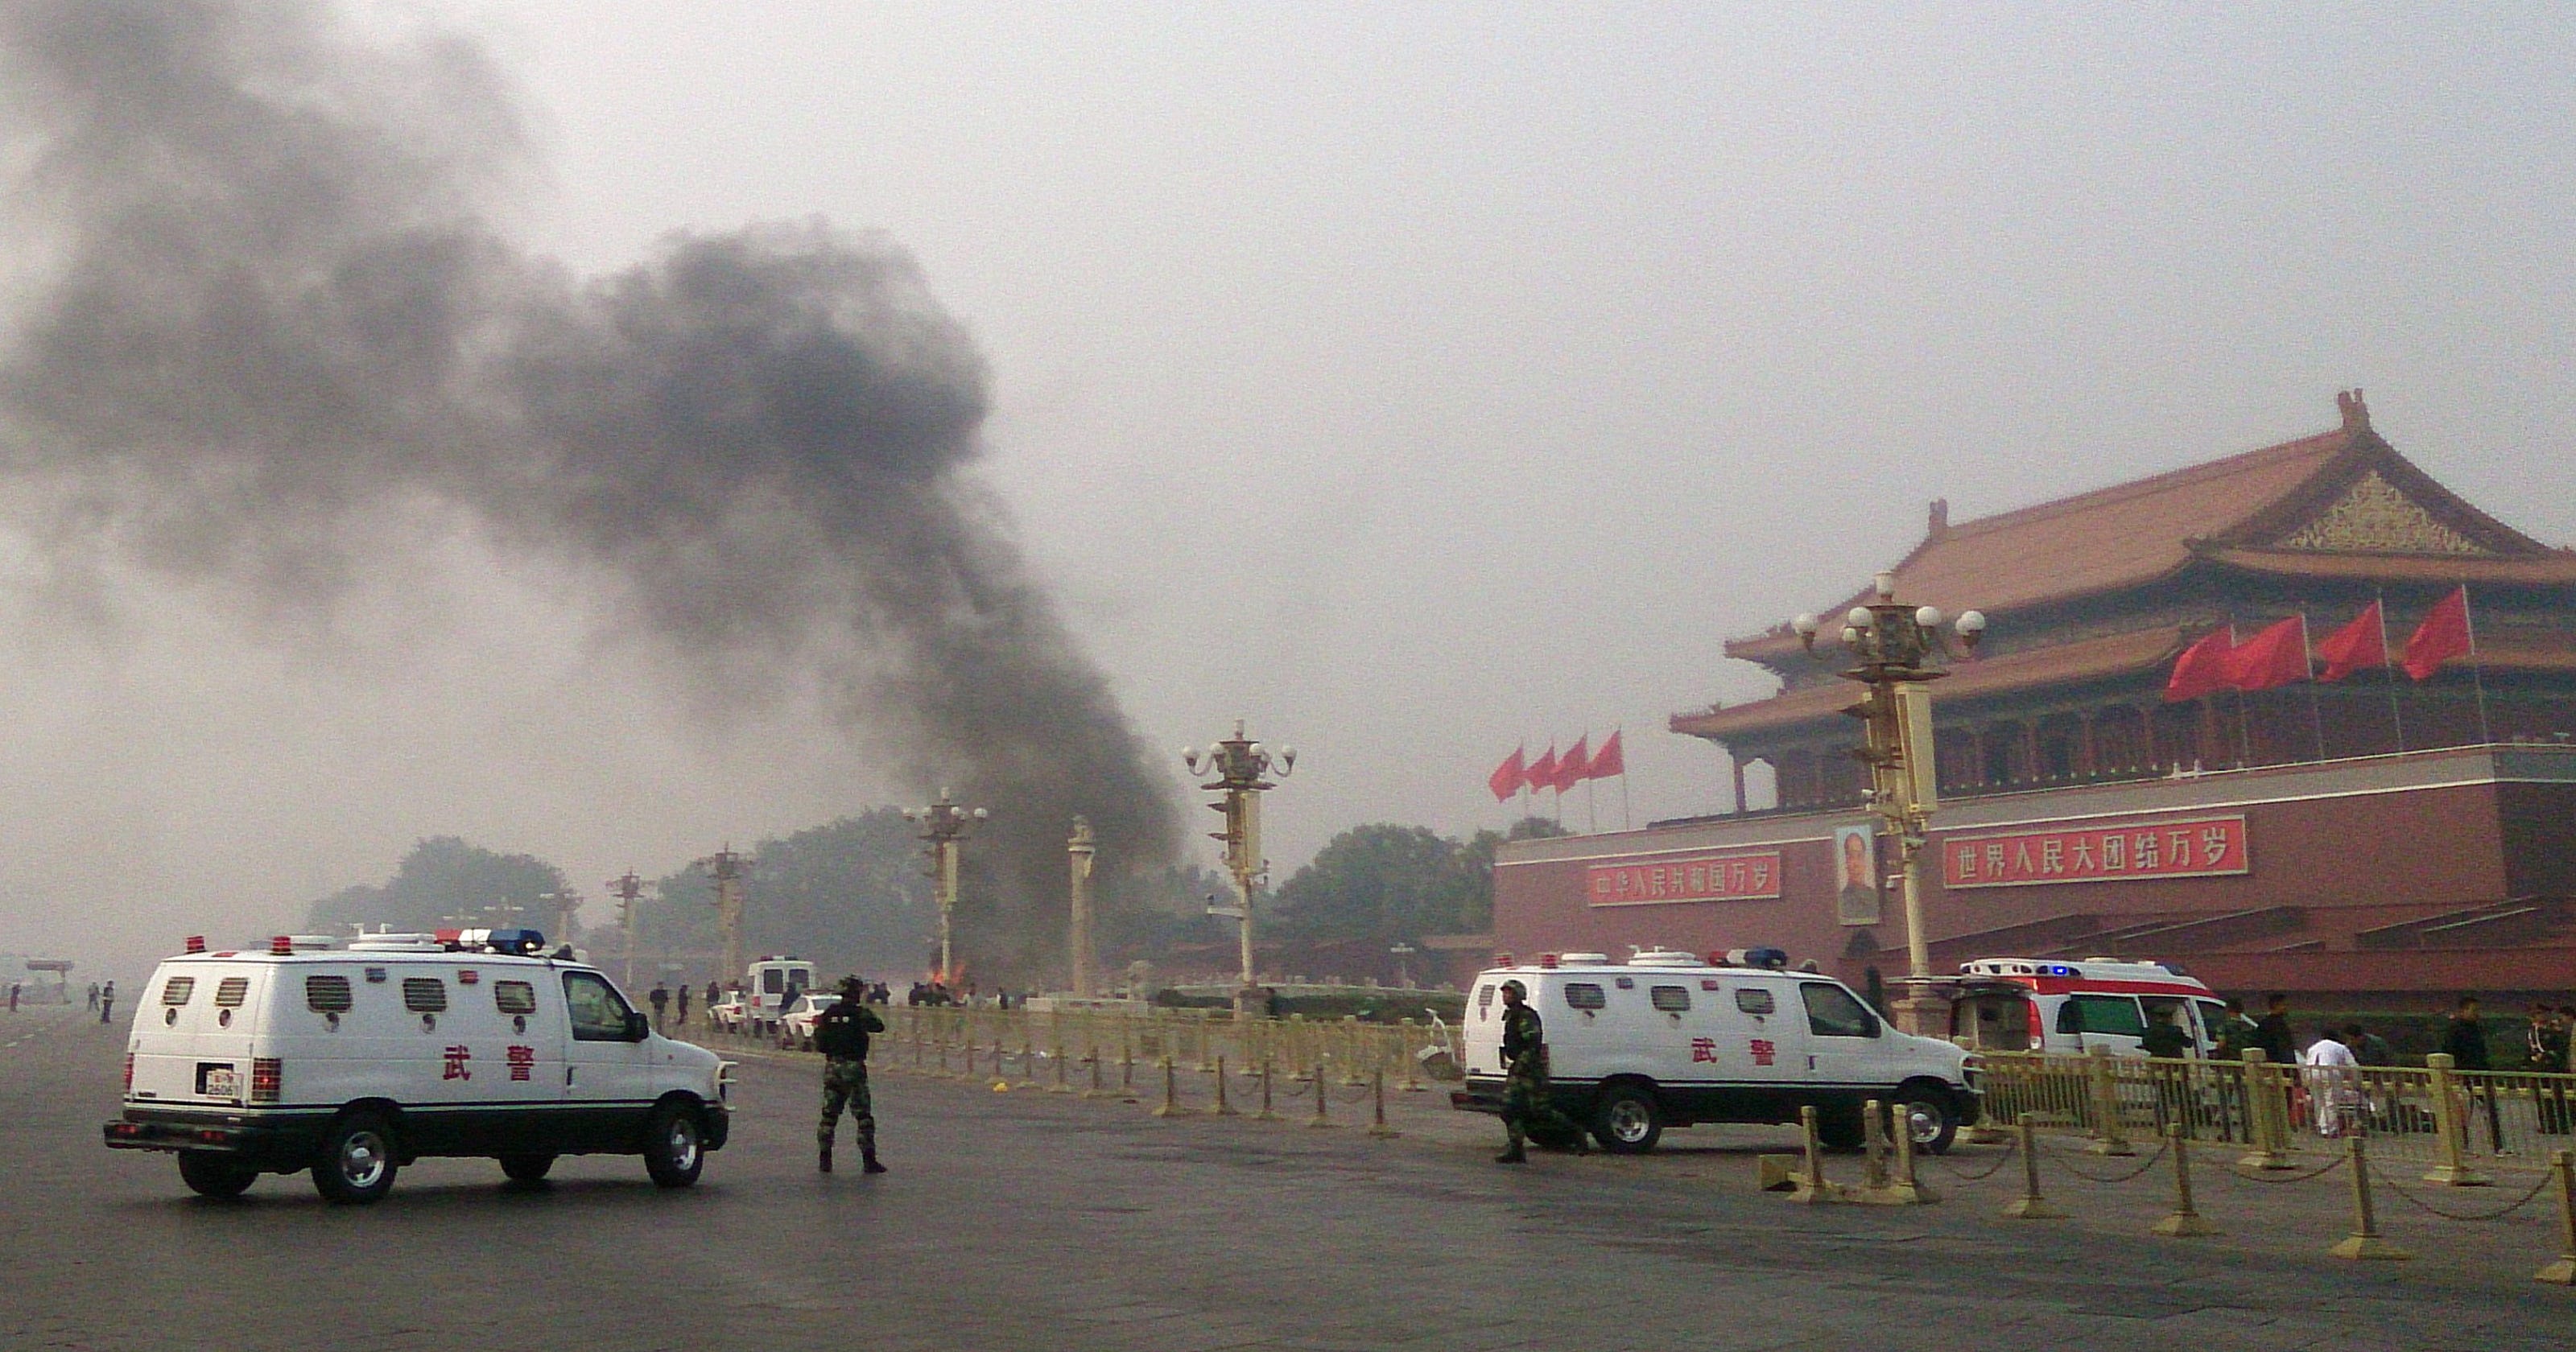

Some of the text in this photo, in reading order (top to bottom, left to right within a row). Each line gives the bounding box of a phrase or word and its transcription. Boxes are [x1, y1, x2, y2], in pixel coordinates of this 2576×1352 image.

[1958, 827, 2227, 880] 世界人民大团结万岁
[1596, 862, 1769, 897] 中华人民共和国万岁
[443, 1045, 534, 1081] 武警
[1691, 1037, 1775, 1066] 武警
